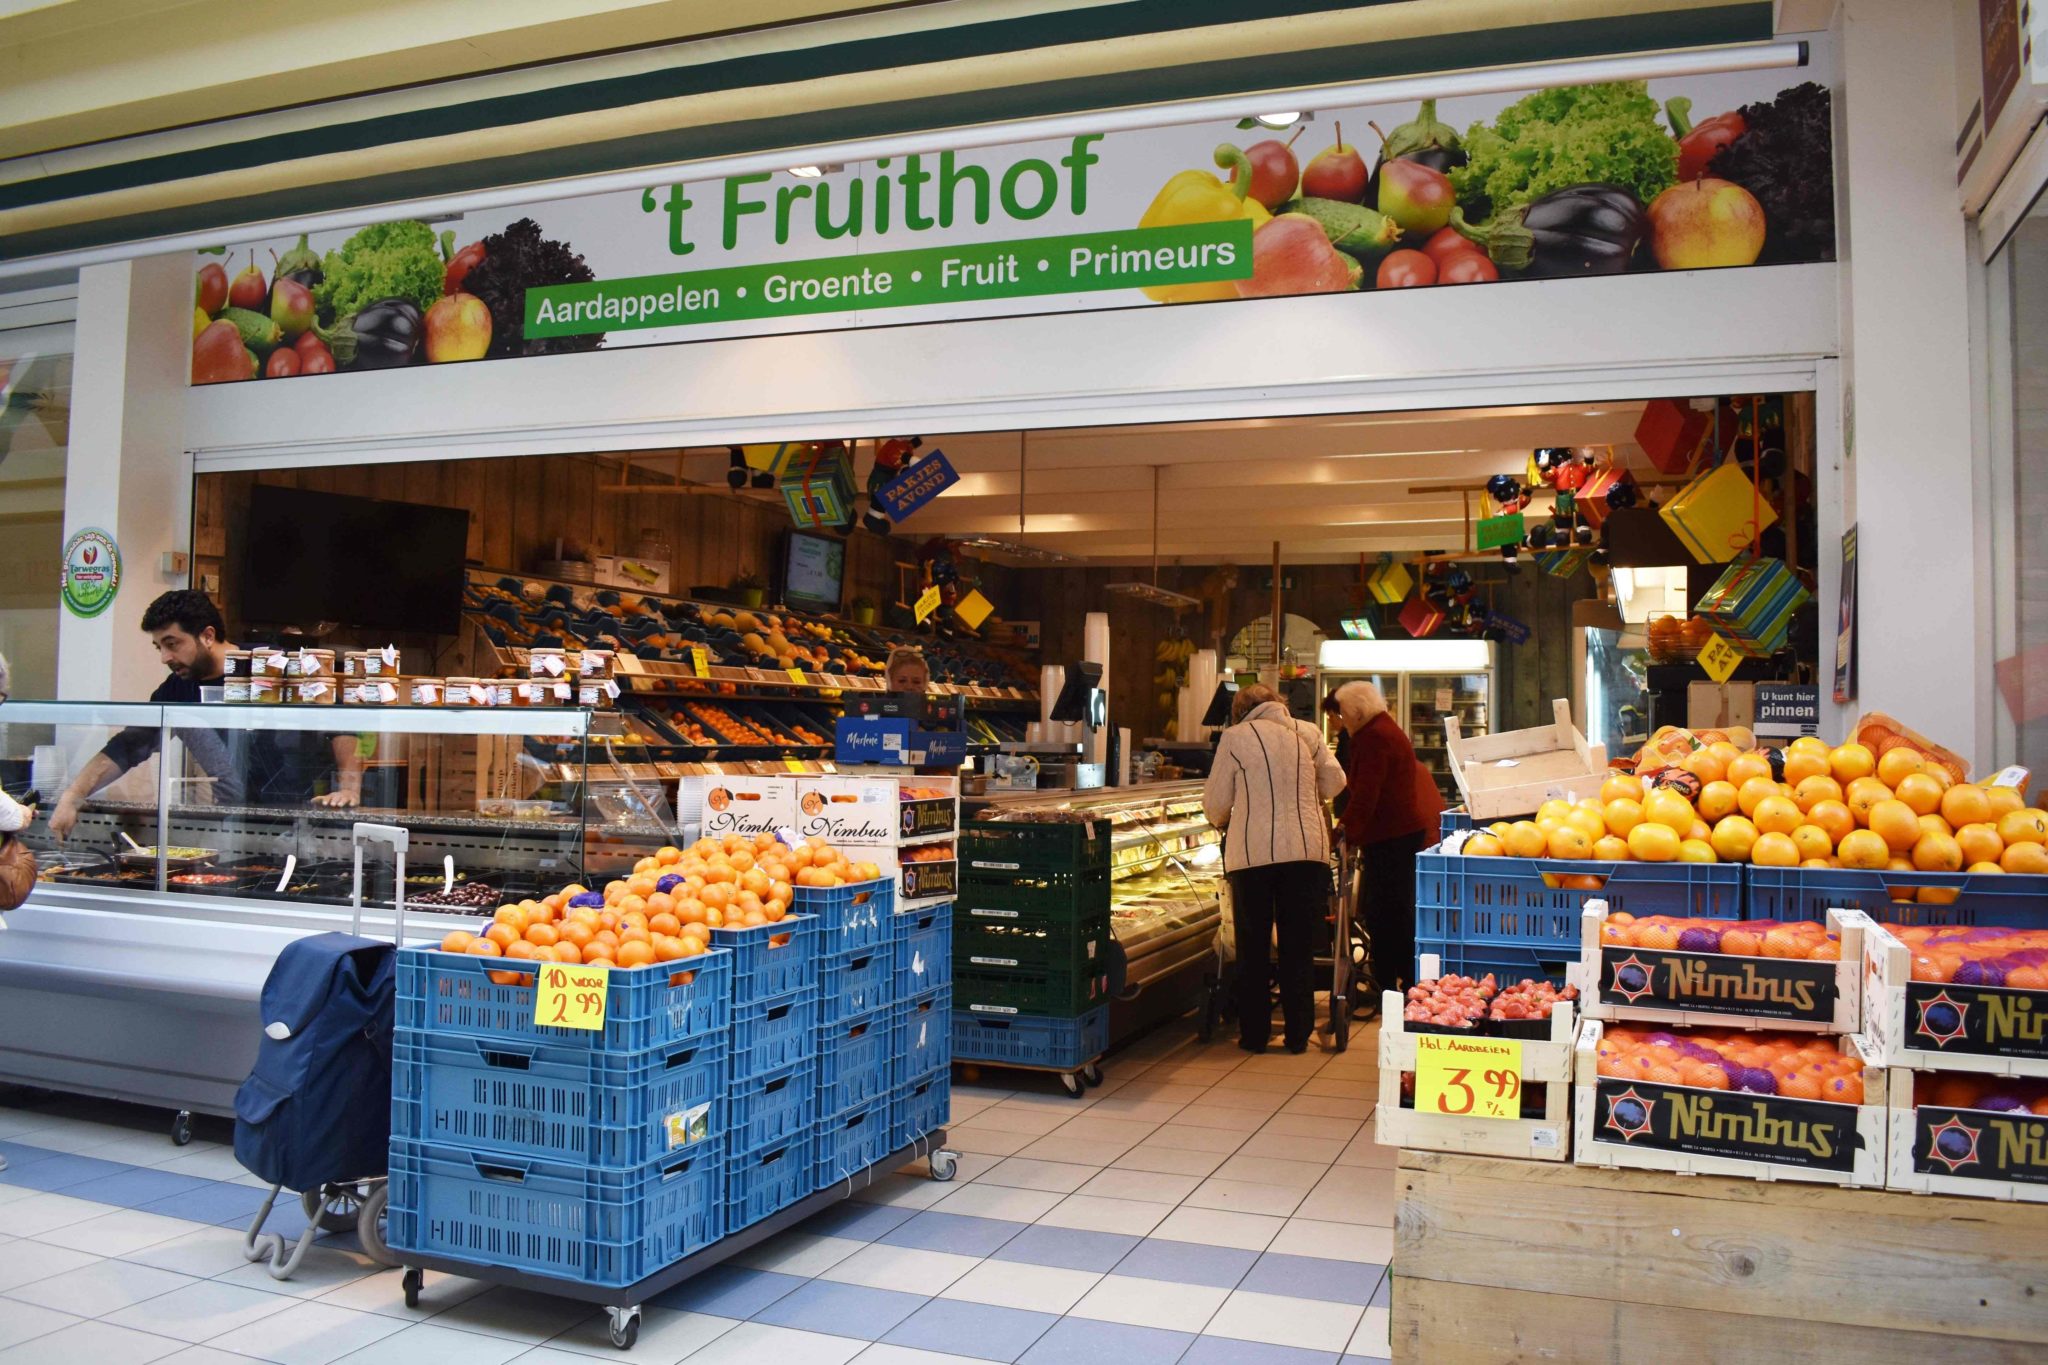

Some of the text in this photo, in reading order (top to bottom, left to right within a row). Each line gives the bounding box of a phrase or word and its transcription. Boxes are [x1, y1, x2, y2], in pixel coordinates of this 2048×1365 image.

[723, 132, 1104, 250] Fruithof
[535, 242, 1236, 325] Aardappelen Groente Fruit Primeurs
[885, 458, 942, 503] PAKJES
[897, 472, 946, 511] AVOND
[69, 564, 110, 574] Tarwegras
[1761, 692, 1815, 701] U kunt hier
[1761, 703, 1814, 719] pinnen
[846, 732, 879, 750] Marlene
[709, 812, 790, 834] Nimbu
[917, 802, 952, 828] Nimbus
[802, 817, 889, 839] Nimbus
[919, 867, 953, 890] Nimbus
[545, 968, 568, 989] 10
[1661, 957, 1816, 1011] Nimbus
[575, 992, 603, 1016] 99
[1483, 1069, 1520, 1100] 99
[1662, 1091, 1834, 1158] Nimbus
[1989, 1119, 2048, 1169] Ni
